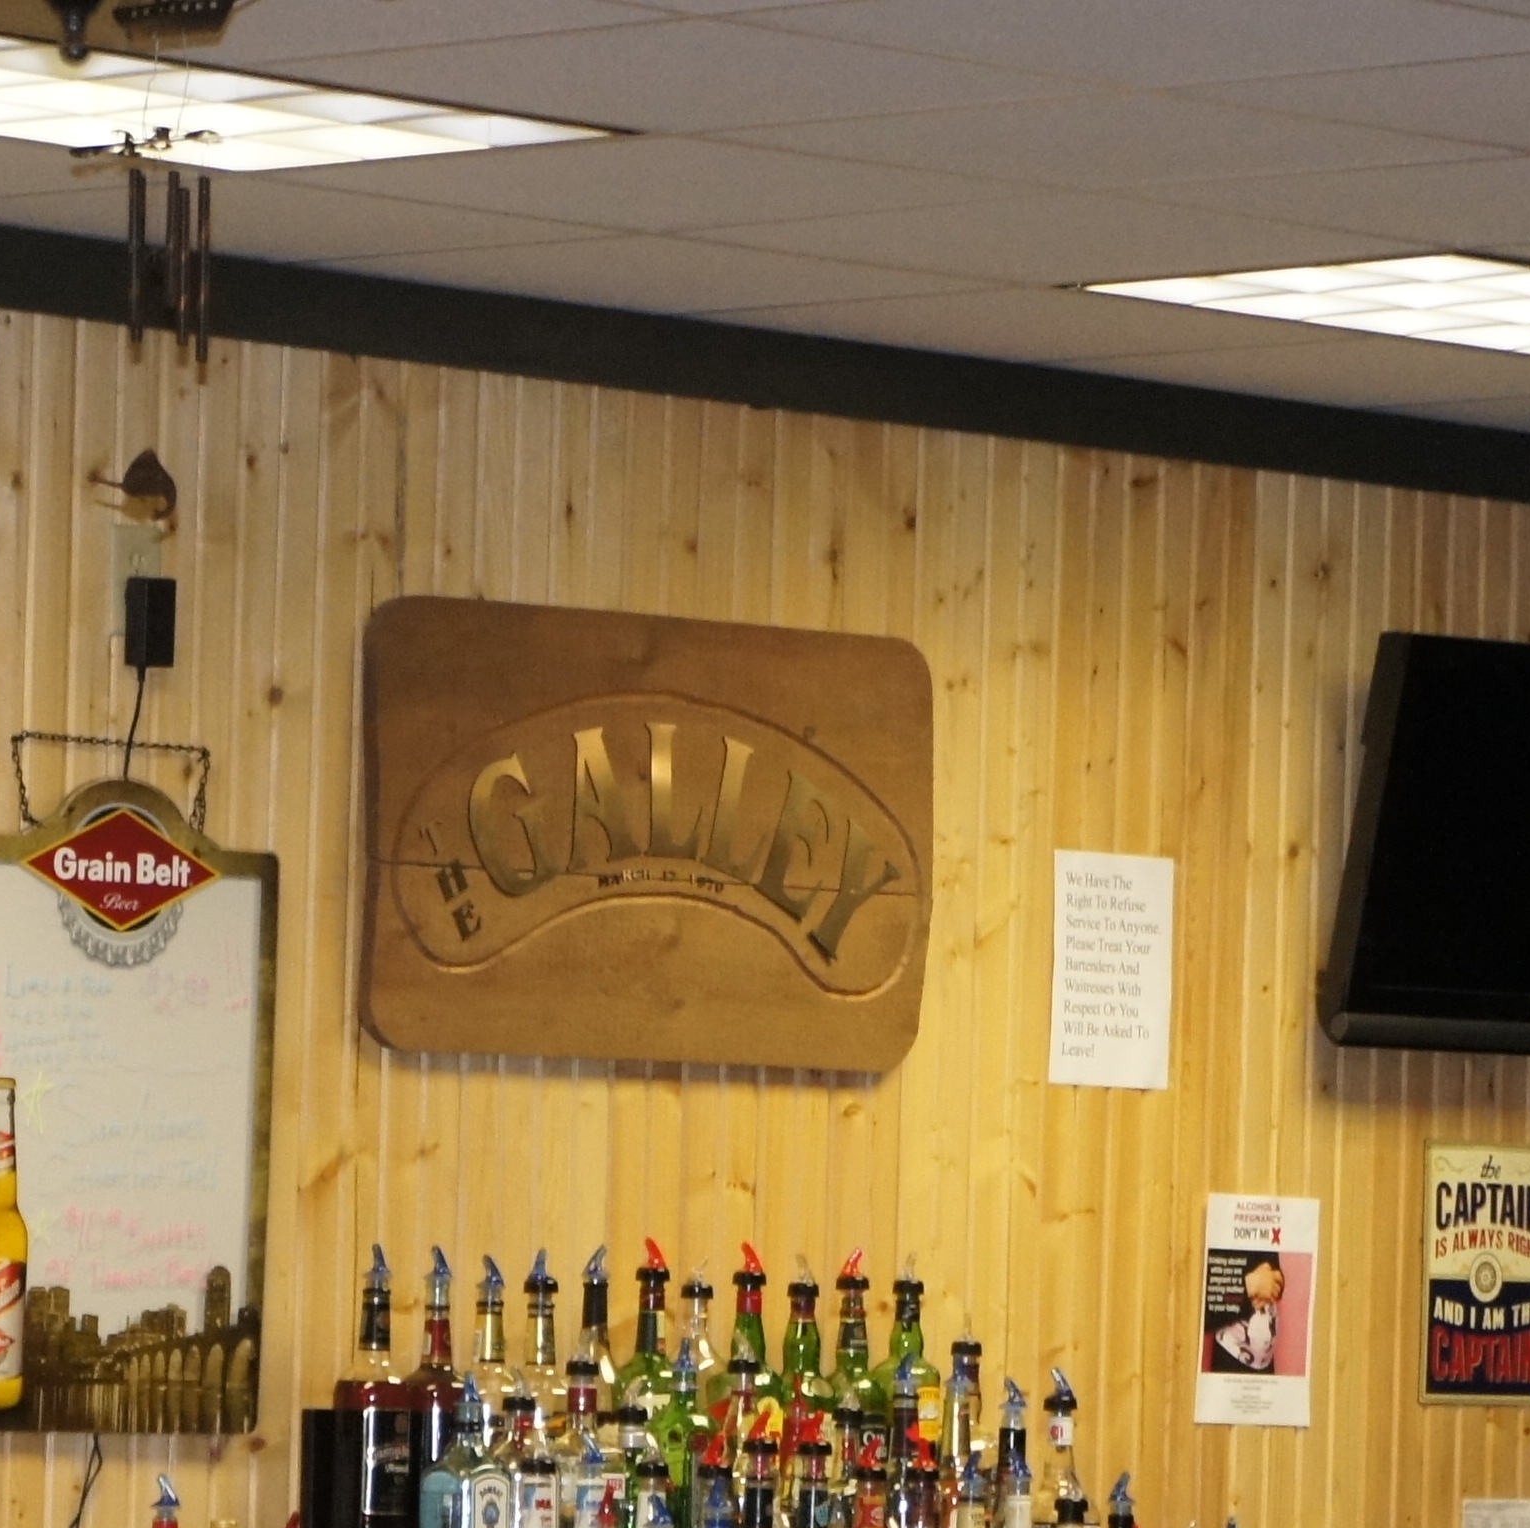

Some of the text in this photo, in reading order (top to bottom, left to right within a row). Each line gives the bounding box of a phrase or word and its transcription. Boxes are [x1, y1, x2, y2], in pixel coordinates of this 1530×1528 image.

[468, 721, 901, 967] GALLEY
[53, 846, 191, 888] Grain Belt
[418, 820, 484, 942] THE
[1065, 871, 1133, 890] We Have The
[99, 892, 141, 911] Beer
[1065, 894, 1146, 913] Right To Refuse
[1065, 916, 1101, 931] Service
[1104, 918, 1117, 931] To
[1065, 937, 1151, 955] Please Treat Your
[1065, 958, 1140, 975] Bartenders And
[1064, 978, 1142, 997] Waitresses With
[1063, 1000, 1139, 1018] Respect Or You
[1063, 1021, 1150, 1039] Will Be Asked To
[1061, 1043, 1095, 1058] Leave!
[1480, 1154, 1502, 1179] the
[1236, 1202, 1272, 1211] ALCOHOL
[1233, 1213, 1281, 1224] PREGNANCY
[1233, 1227, 1258, 1240] DON'T
[1435, 1238, 1448, 1260] IS
[1452, 1229, 1503, 1252] ALWAYS
[1433, 1297, 1464, 1327] AND
[1470, 1306, 1476, 1329] I
[1482, 1306, 1505, 1331] AM
